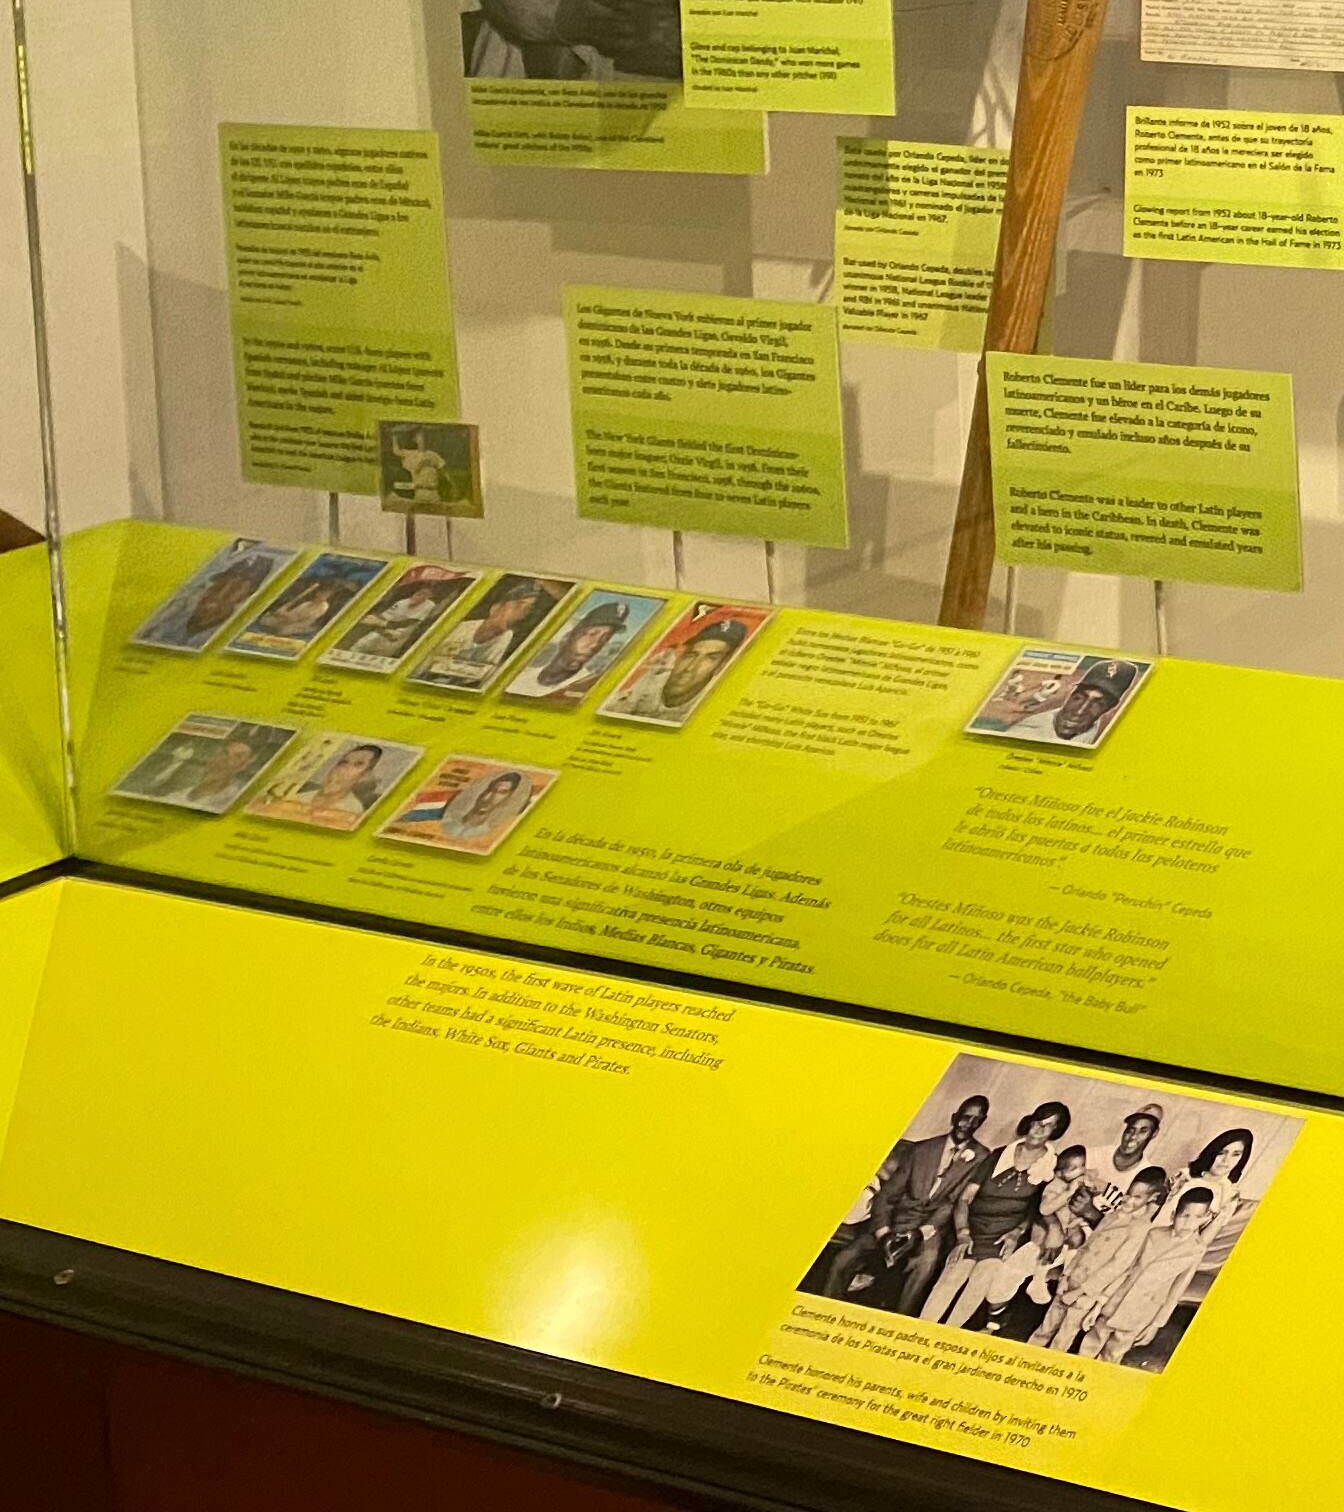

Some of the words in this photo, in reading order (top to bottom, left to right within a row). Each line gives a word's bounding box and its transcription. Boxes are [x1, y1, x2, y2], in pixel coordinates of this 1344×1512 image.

[422, 953, 436, 967] In
[438, 955, 460, 971] the
[460, 963, 497, 979] 1950s,
[502, 969, 523, 983] the
[523, 973, 548, 987] first
[553, 979, 584, 993] wave
[584, 984, 602, 1001] of
[601, 986, 633, 1004] Latin
[634, 991, 680, 1012] players
[682, 1001, 736, 1023] reached
